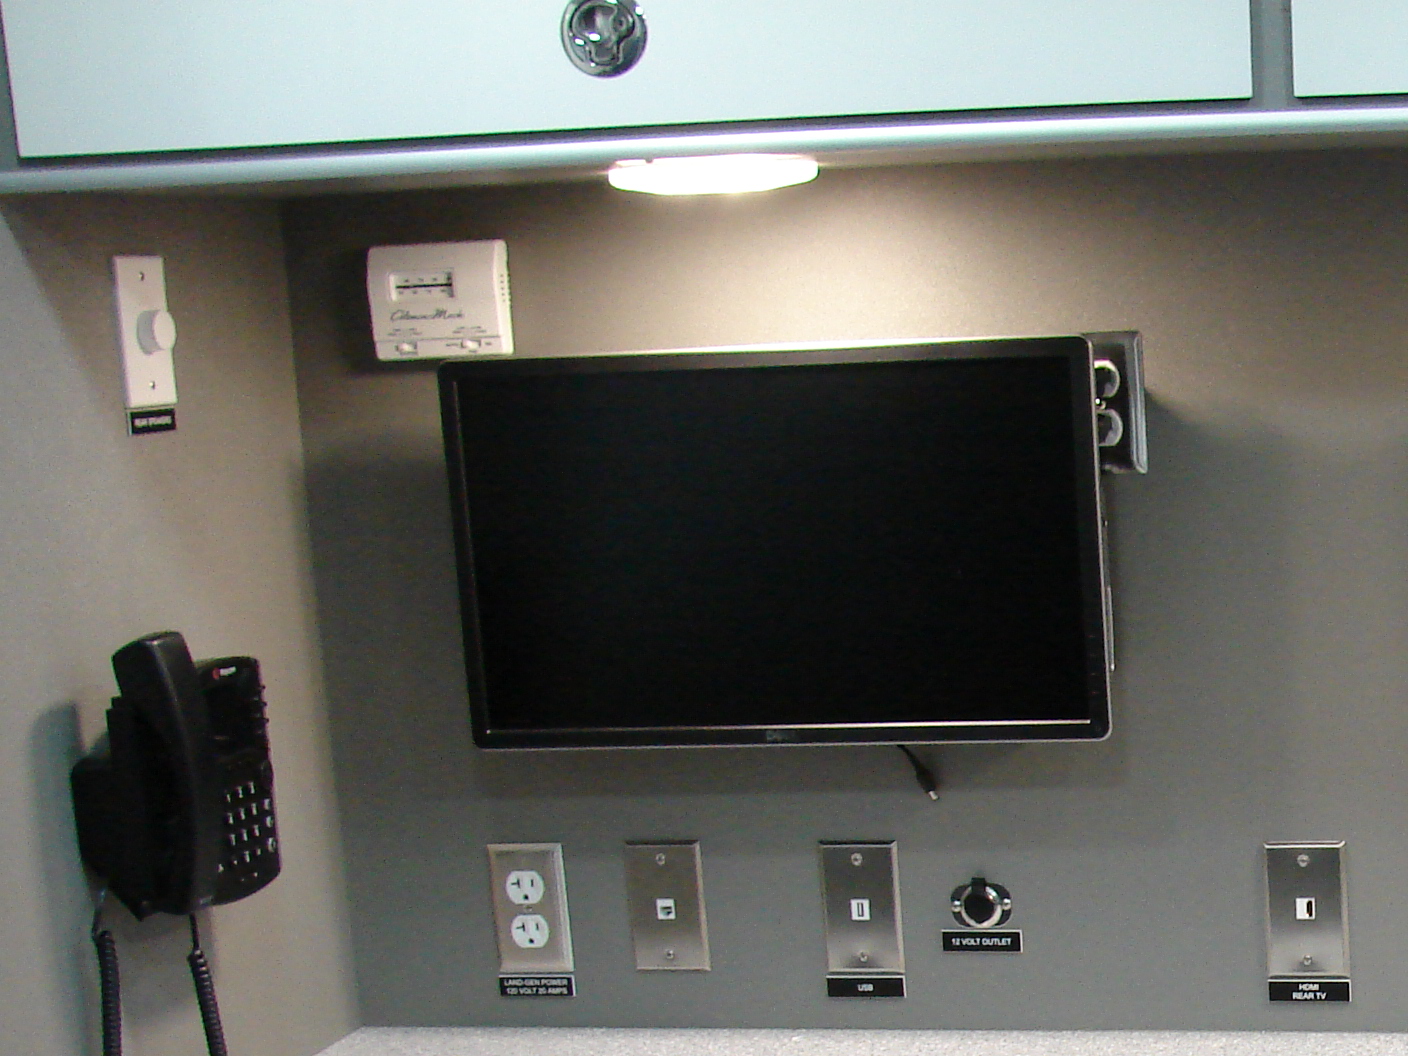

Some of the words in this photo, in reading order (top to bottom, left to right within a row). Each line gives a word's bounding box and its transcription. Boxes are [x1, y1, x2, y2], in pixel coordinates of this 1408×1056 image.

[961, 937, 980, 946] VOLT
[981, 937, 1011, 946] OUTLET
[519, 987, 537, 995] VOLT
[548, 986, 568, 995] AMPS
[857, 983, 874, 992] USB
[1292, 991, 1315, 1000] REAR
[1316, 991, 1327, 1000] TV
